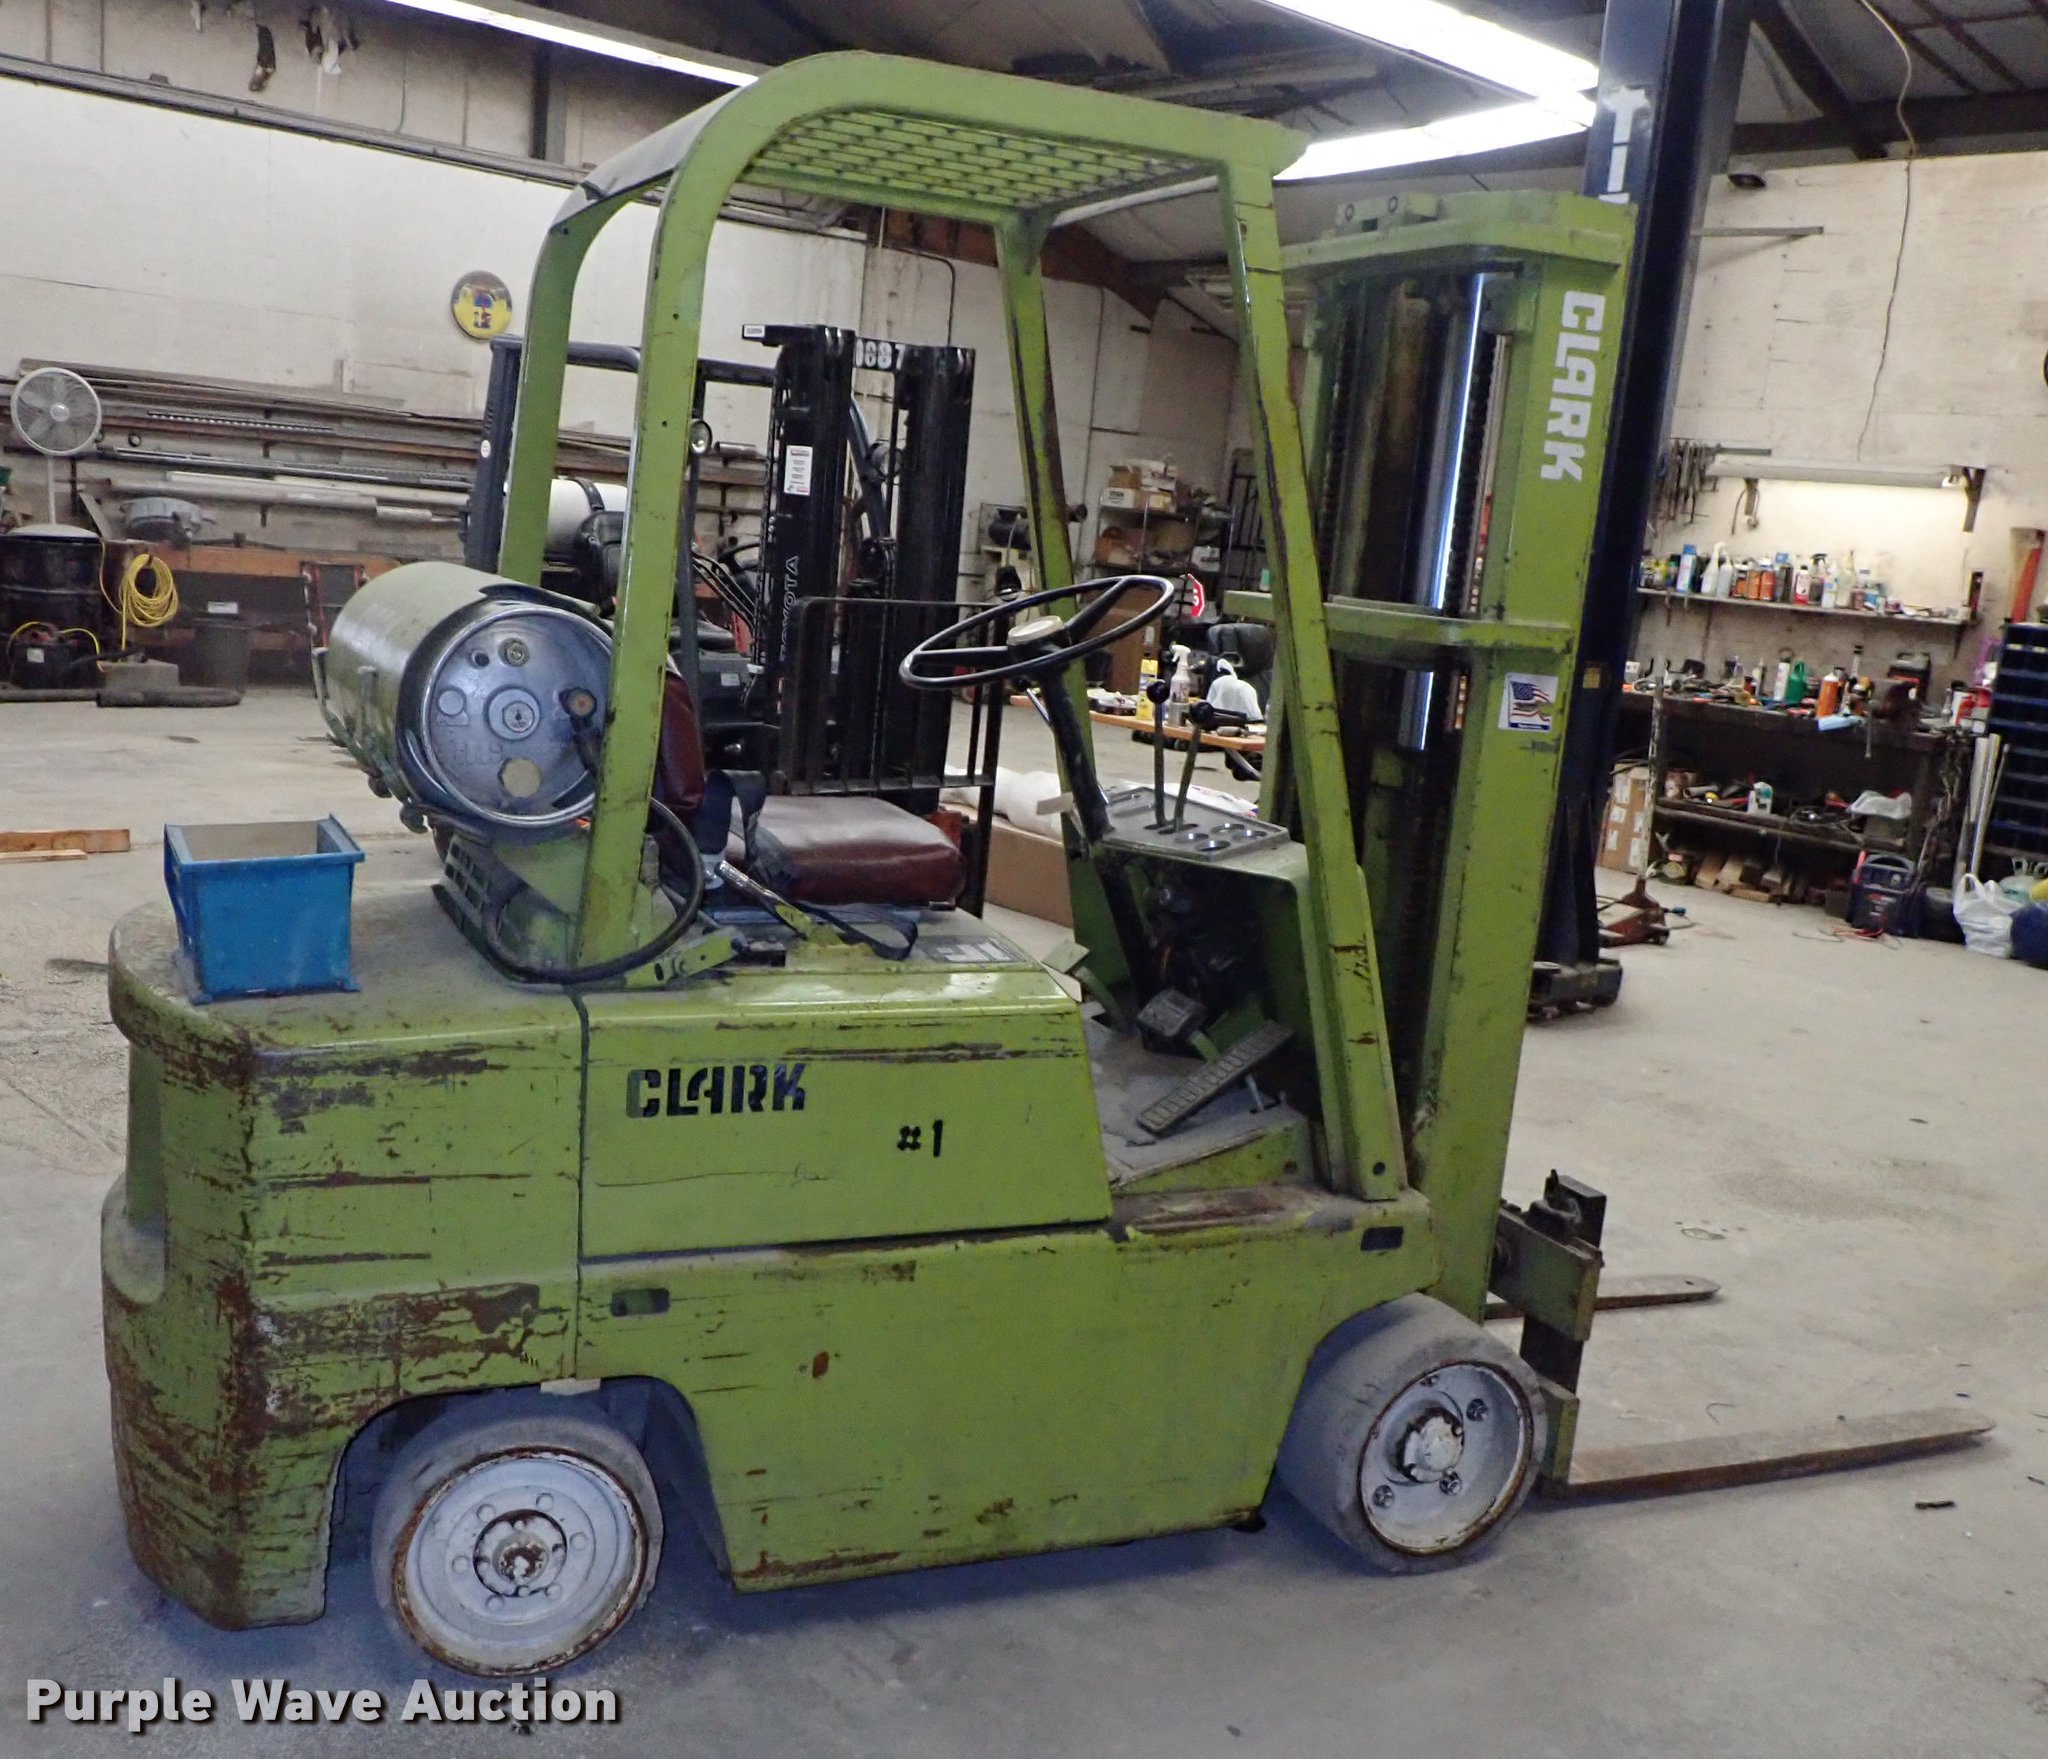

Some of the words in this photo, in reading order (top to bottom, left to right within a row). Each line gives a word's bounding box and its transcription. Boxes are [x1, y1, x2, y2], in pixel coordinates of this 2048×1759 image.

[1540, 290, 1606, 482] CLARK
[625, 1063, 807, 1119] CLARK
[897, 1119, 944, 1158] #1
